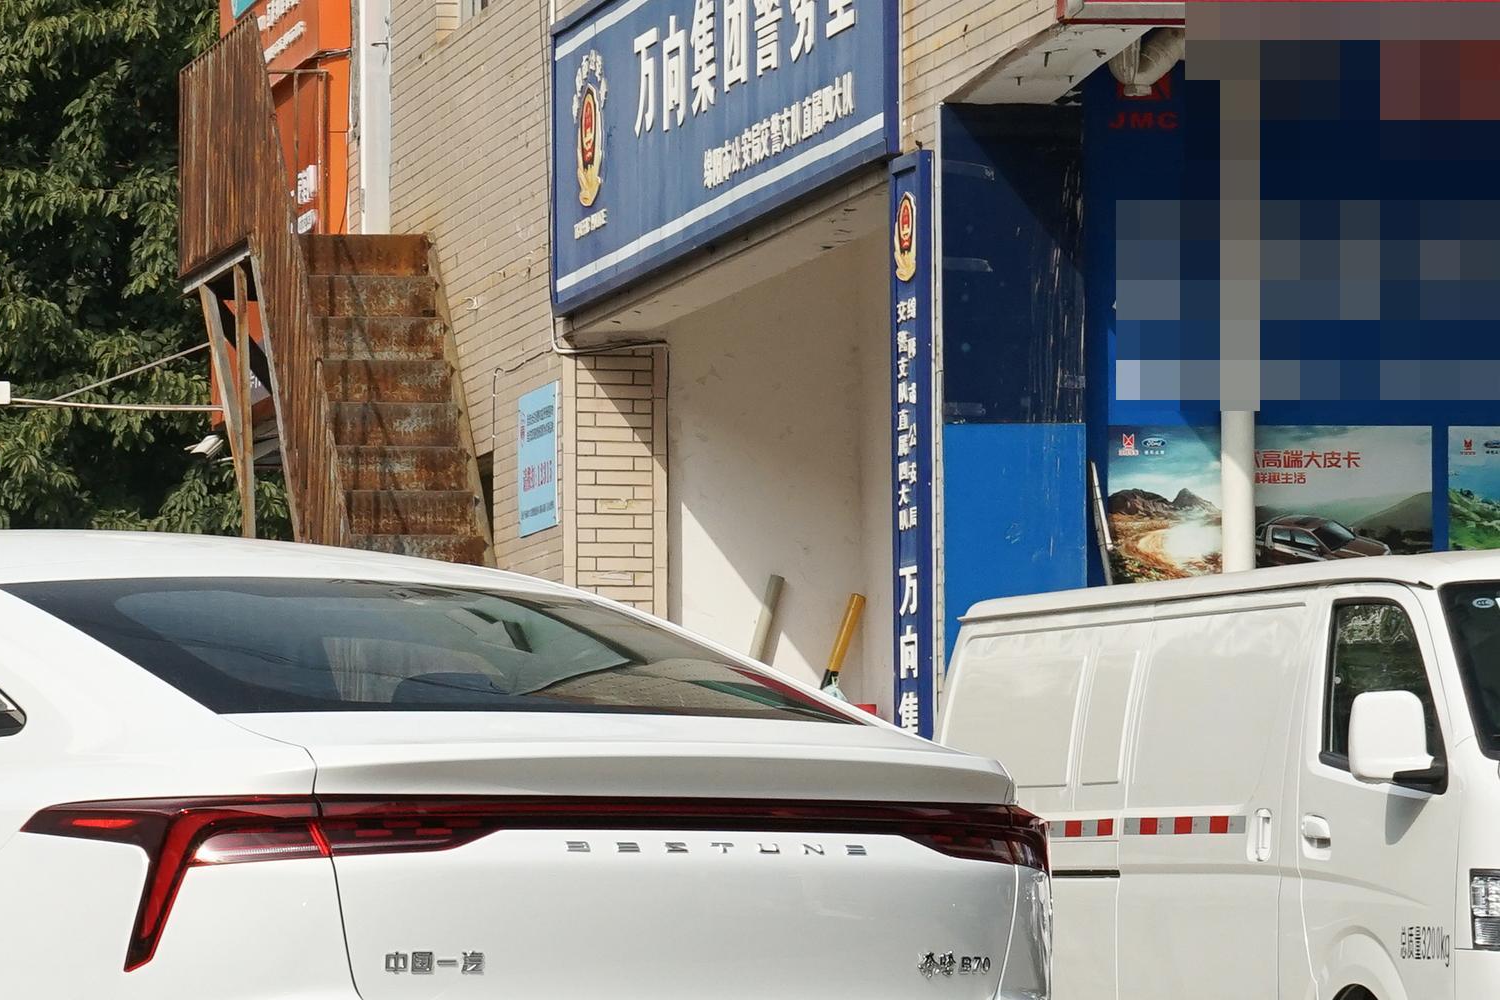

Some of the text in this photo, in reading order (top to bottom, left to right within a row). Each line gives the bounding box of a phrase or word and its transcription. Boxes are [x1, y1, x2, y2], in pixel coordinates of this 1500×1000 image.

[1108, 111, 1180, 129] JMC
[565, 840, 868, 856] BESTUNE
[385, 951, 485, 975] 中国一汽
[960, 956, 991, 974] B70
